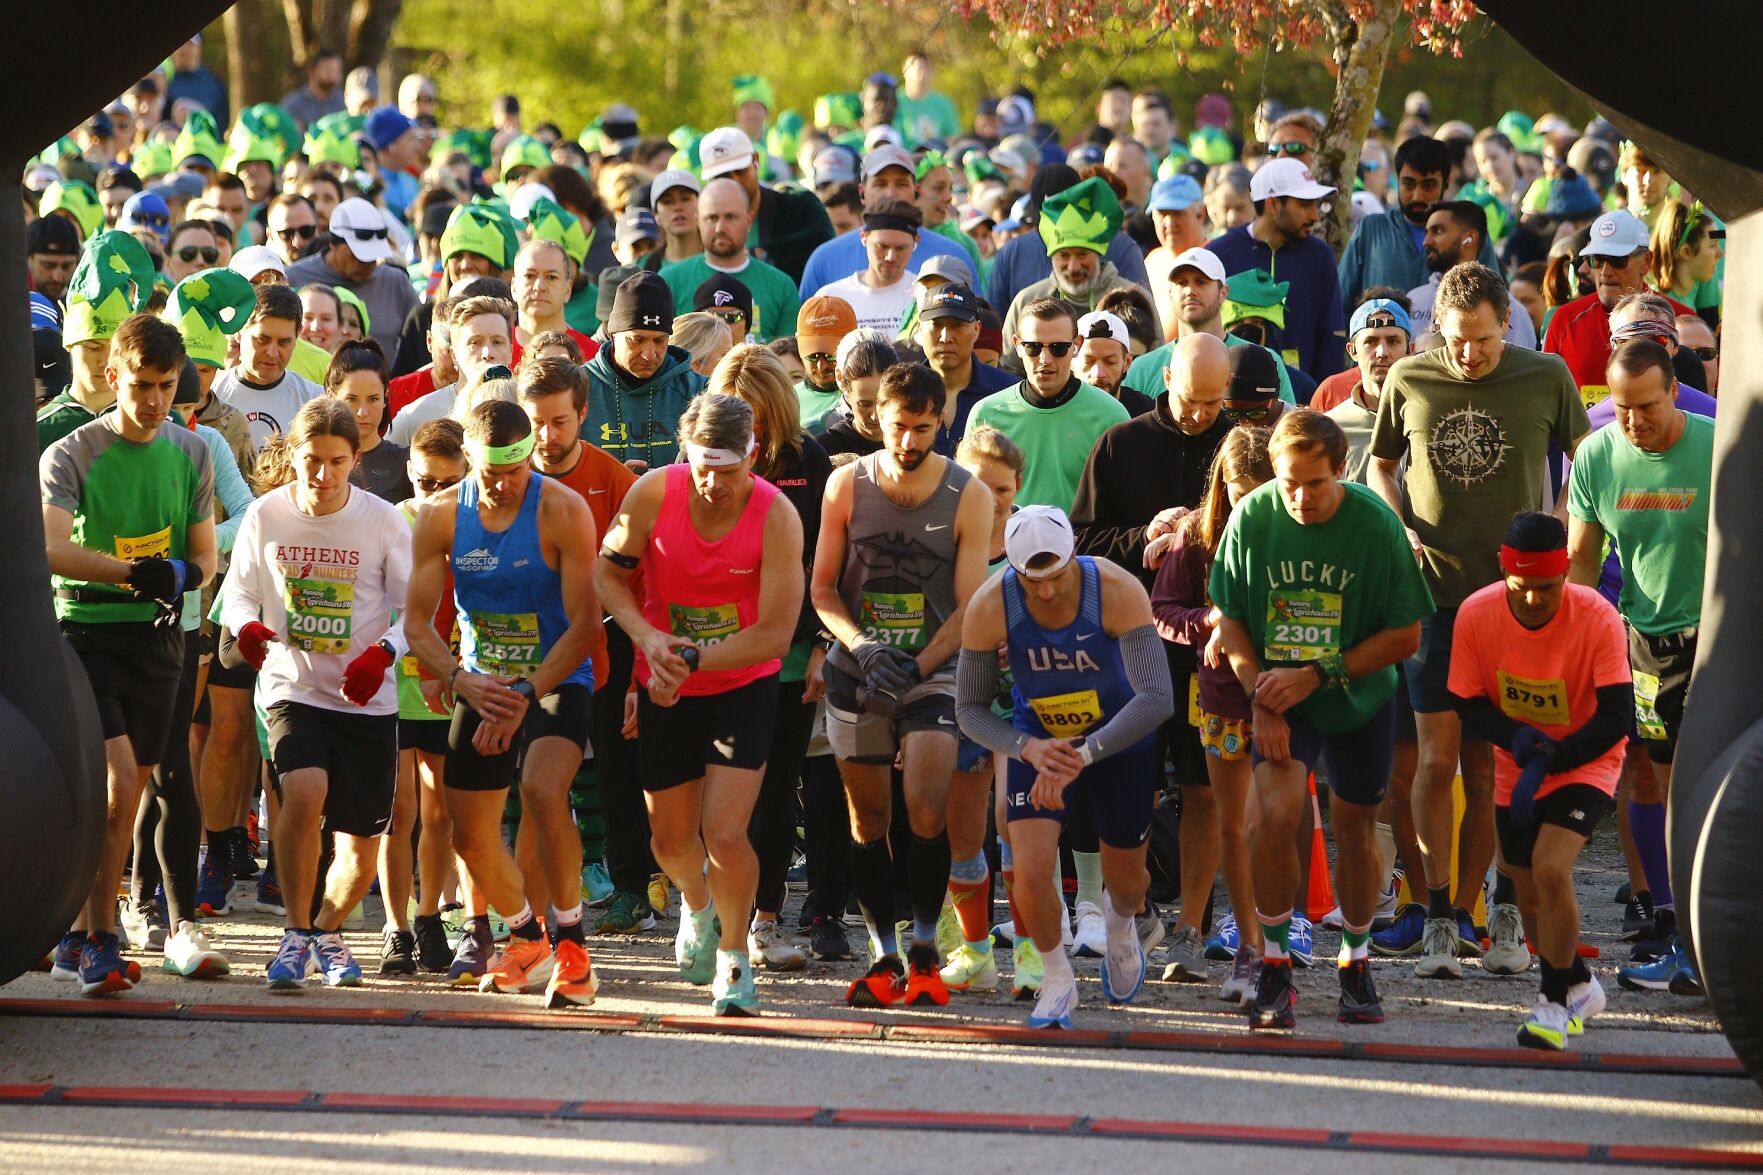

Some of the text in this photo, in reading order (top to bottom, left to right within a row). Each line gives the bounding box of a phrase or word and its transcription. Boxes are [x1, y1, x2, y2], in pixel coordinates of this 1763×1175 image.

[275, 546, 360, 566] ATHENS
[455, 556, 499, 566] INSPECTOR
[313, 566, 358, 580] RUNNERS
[1266, 560, 1355, 591] LUCKY
[291, 613, 346, 635] 2000
[1274, 624, 1332, 644] 2301
[864, 626, 920, 645] 2377
[481, 642, 536, 660] 2527
[1027, 646, 1100, 673] USA
[1506, 686, 1559, 708] 8791
[1040, 711, 1094, 726] 8802
